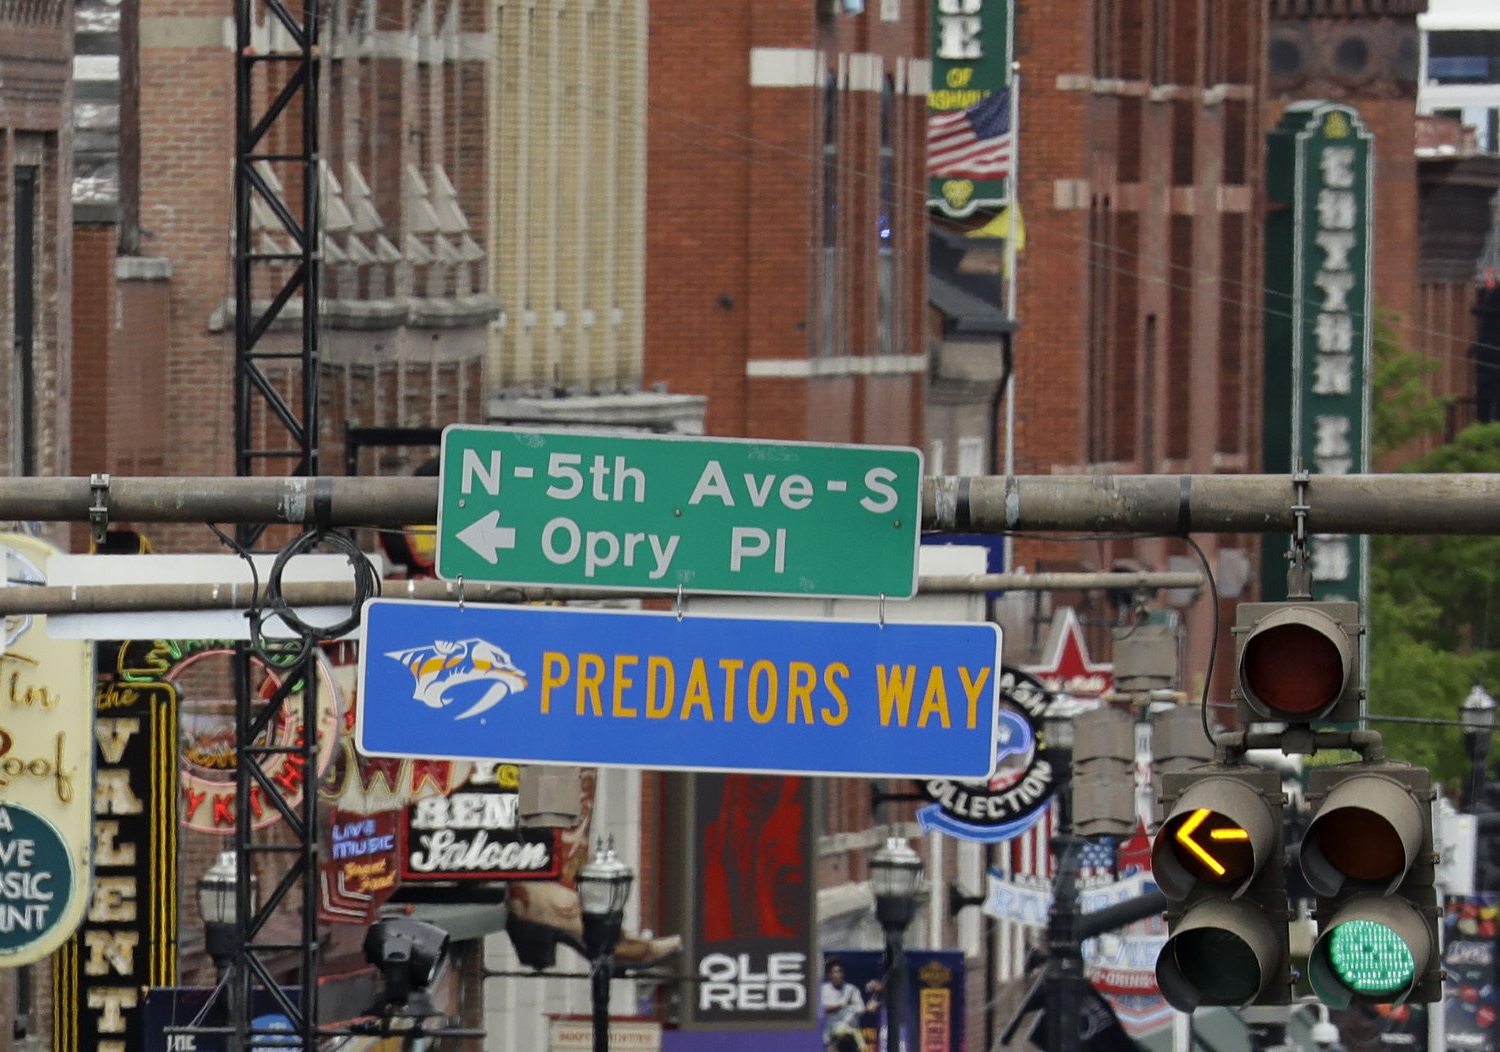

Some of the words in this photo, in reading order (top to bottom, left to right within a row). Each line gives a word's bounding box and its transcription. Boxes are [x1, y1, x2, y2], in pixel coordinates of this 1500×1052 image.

[541, 516, 681, 579] Opry
[730, 527, 788, 573] Pl
[540, 651, 851, 727] PREDATORS
[876, 663, 992, 730] WAY
[926, 759, 1053, 820] OLLECTION
[409, 829, 550, 872] Saloon
[700, 952, 806, 981] OLE
[700, 981, 807, 1011] RED
